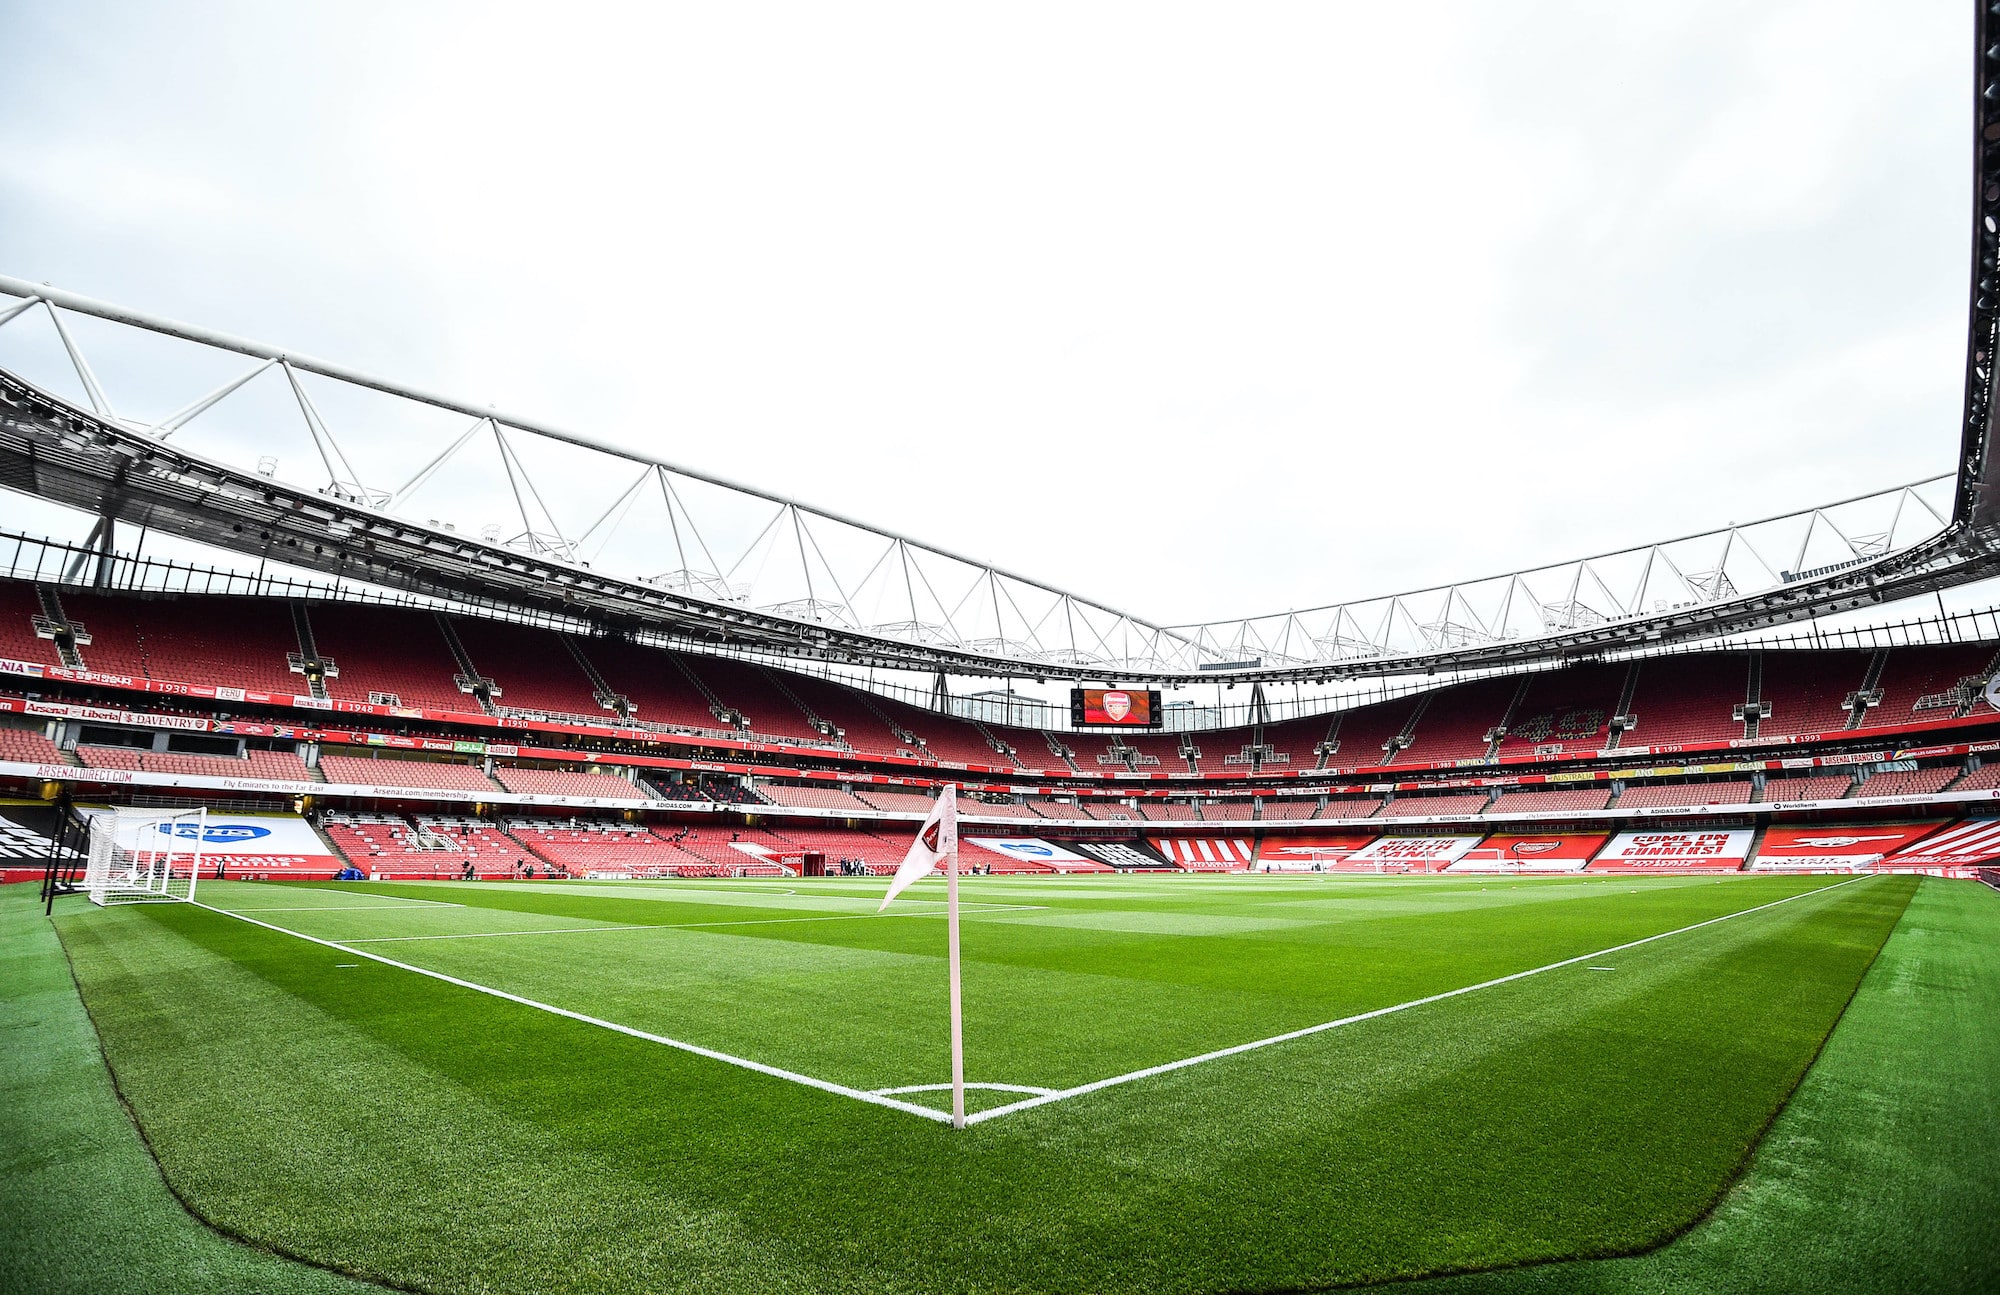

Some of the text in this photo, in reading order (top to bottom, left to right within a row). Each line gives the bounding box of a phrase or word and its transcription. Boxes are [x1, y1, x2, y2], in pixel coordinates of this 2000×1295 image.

[158, 683, 188, 694] 1938
[221, 688, 241, 698] PERU
[27, 703, 119, 721] Arsenal Liberia
[349, 703, 374, 713] 1948
[136, 715, 194, 729] DAVENTRY
[508, 720, 529, 728] 1950
[639, 732, 657, 741] 1953
[1800, 734, 1821, 743] 1993
[422, 740, 453, 750] Arsenal
[1664, 745, 1683, 753] 1993
[1456, 759, 1486, 767] ANFIELD
[1825, 753, 1874, 764] ARSENAL FRANCE
[690, 763, 726, 772] Arsenal.com
[1635, 761, 1765, 777] AND AND AGAIN
[36, 765, 132, 782] ARSENALDIRECT.COM
[1553, 772, 1594, 781] AUSTRALIA
[223, 780, 236, 788] Fly
[237, 780, 270, 789] Emirates
[308, 784, 324, 792] East
[373, 787, 468, 799] Arsenal.com/membership
[1632, 834, 1692, 842] COME
[1622, 846, 1724, 856] GUNNERS!
